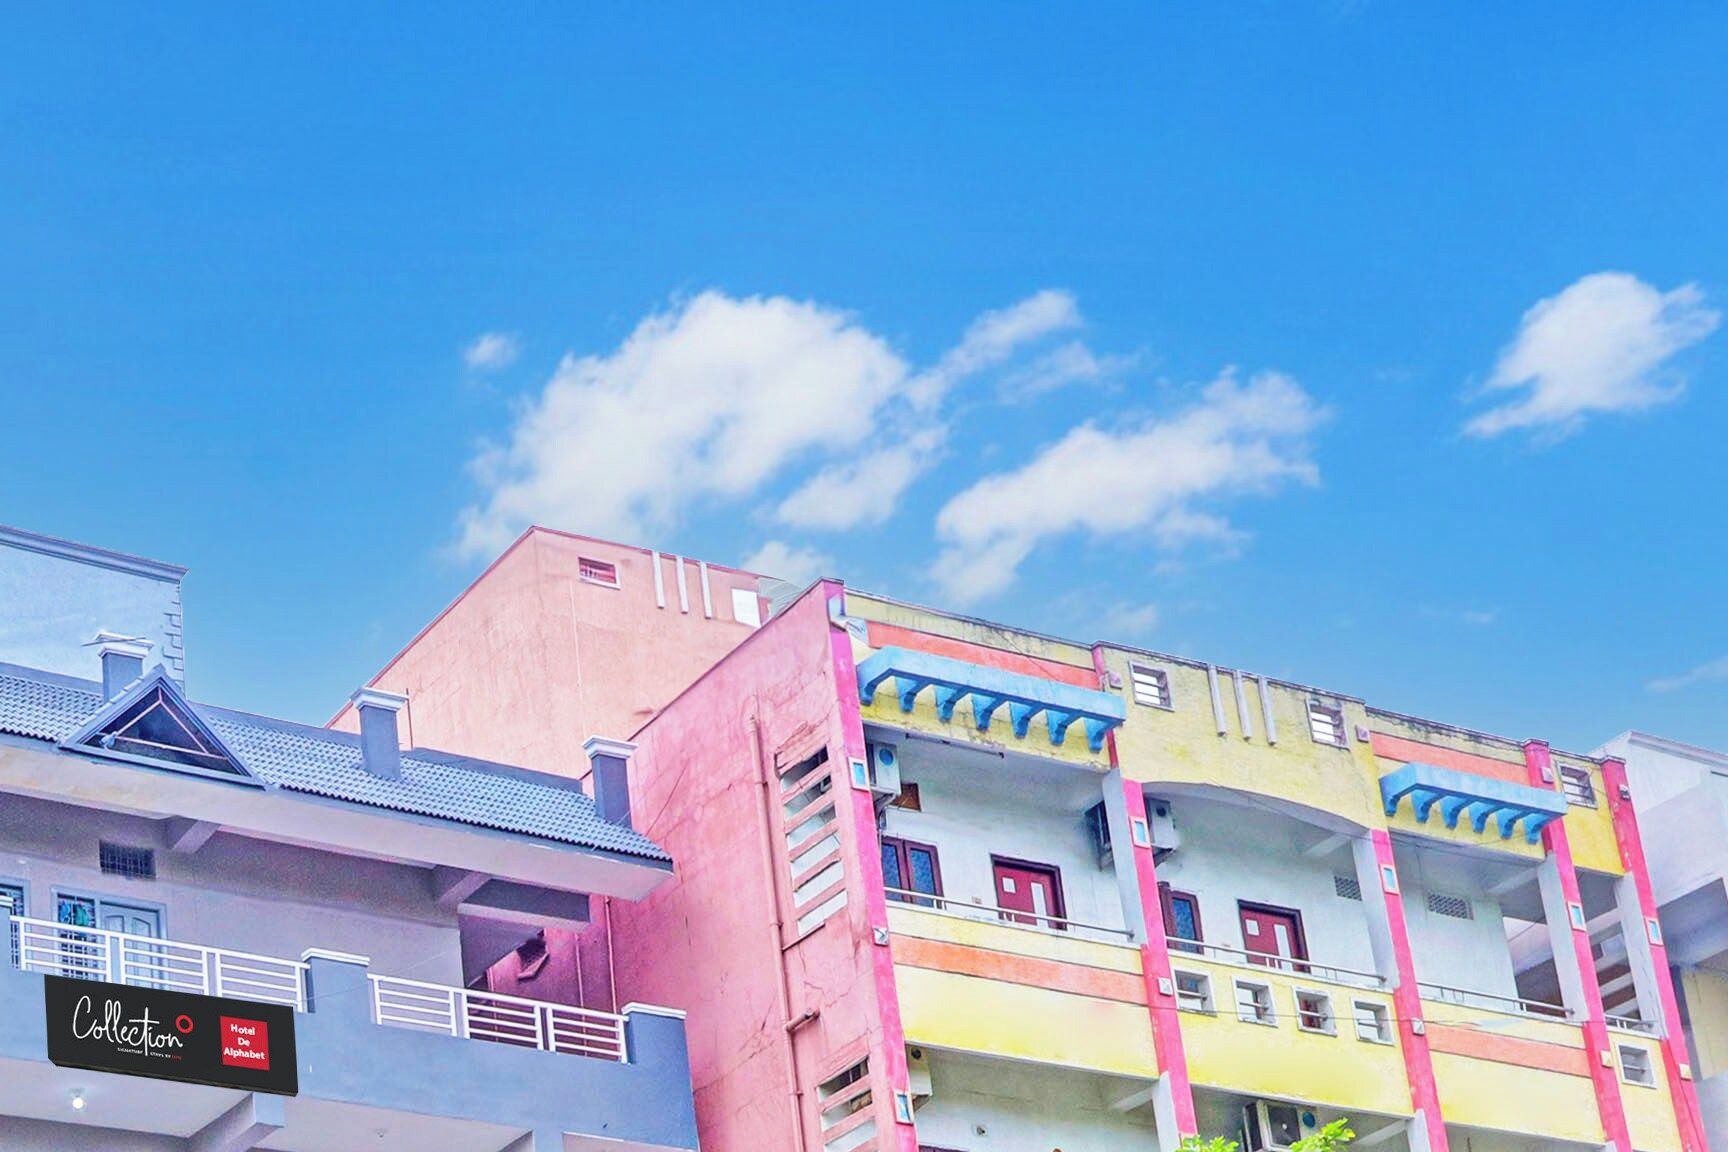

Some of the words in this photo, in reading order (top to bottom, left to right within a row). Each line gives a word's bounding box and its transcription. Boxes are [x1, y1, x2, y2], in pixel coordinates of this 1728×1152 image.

[73, 996, 183, 1056] Collection
[230, 1023, 256, 1036] Hotel
[237, 1037, 251, 1047] De
[223, 1047, 266, 1060] Alphabet
